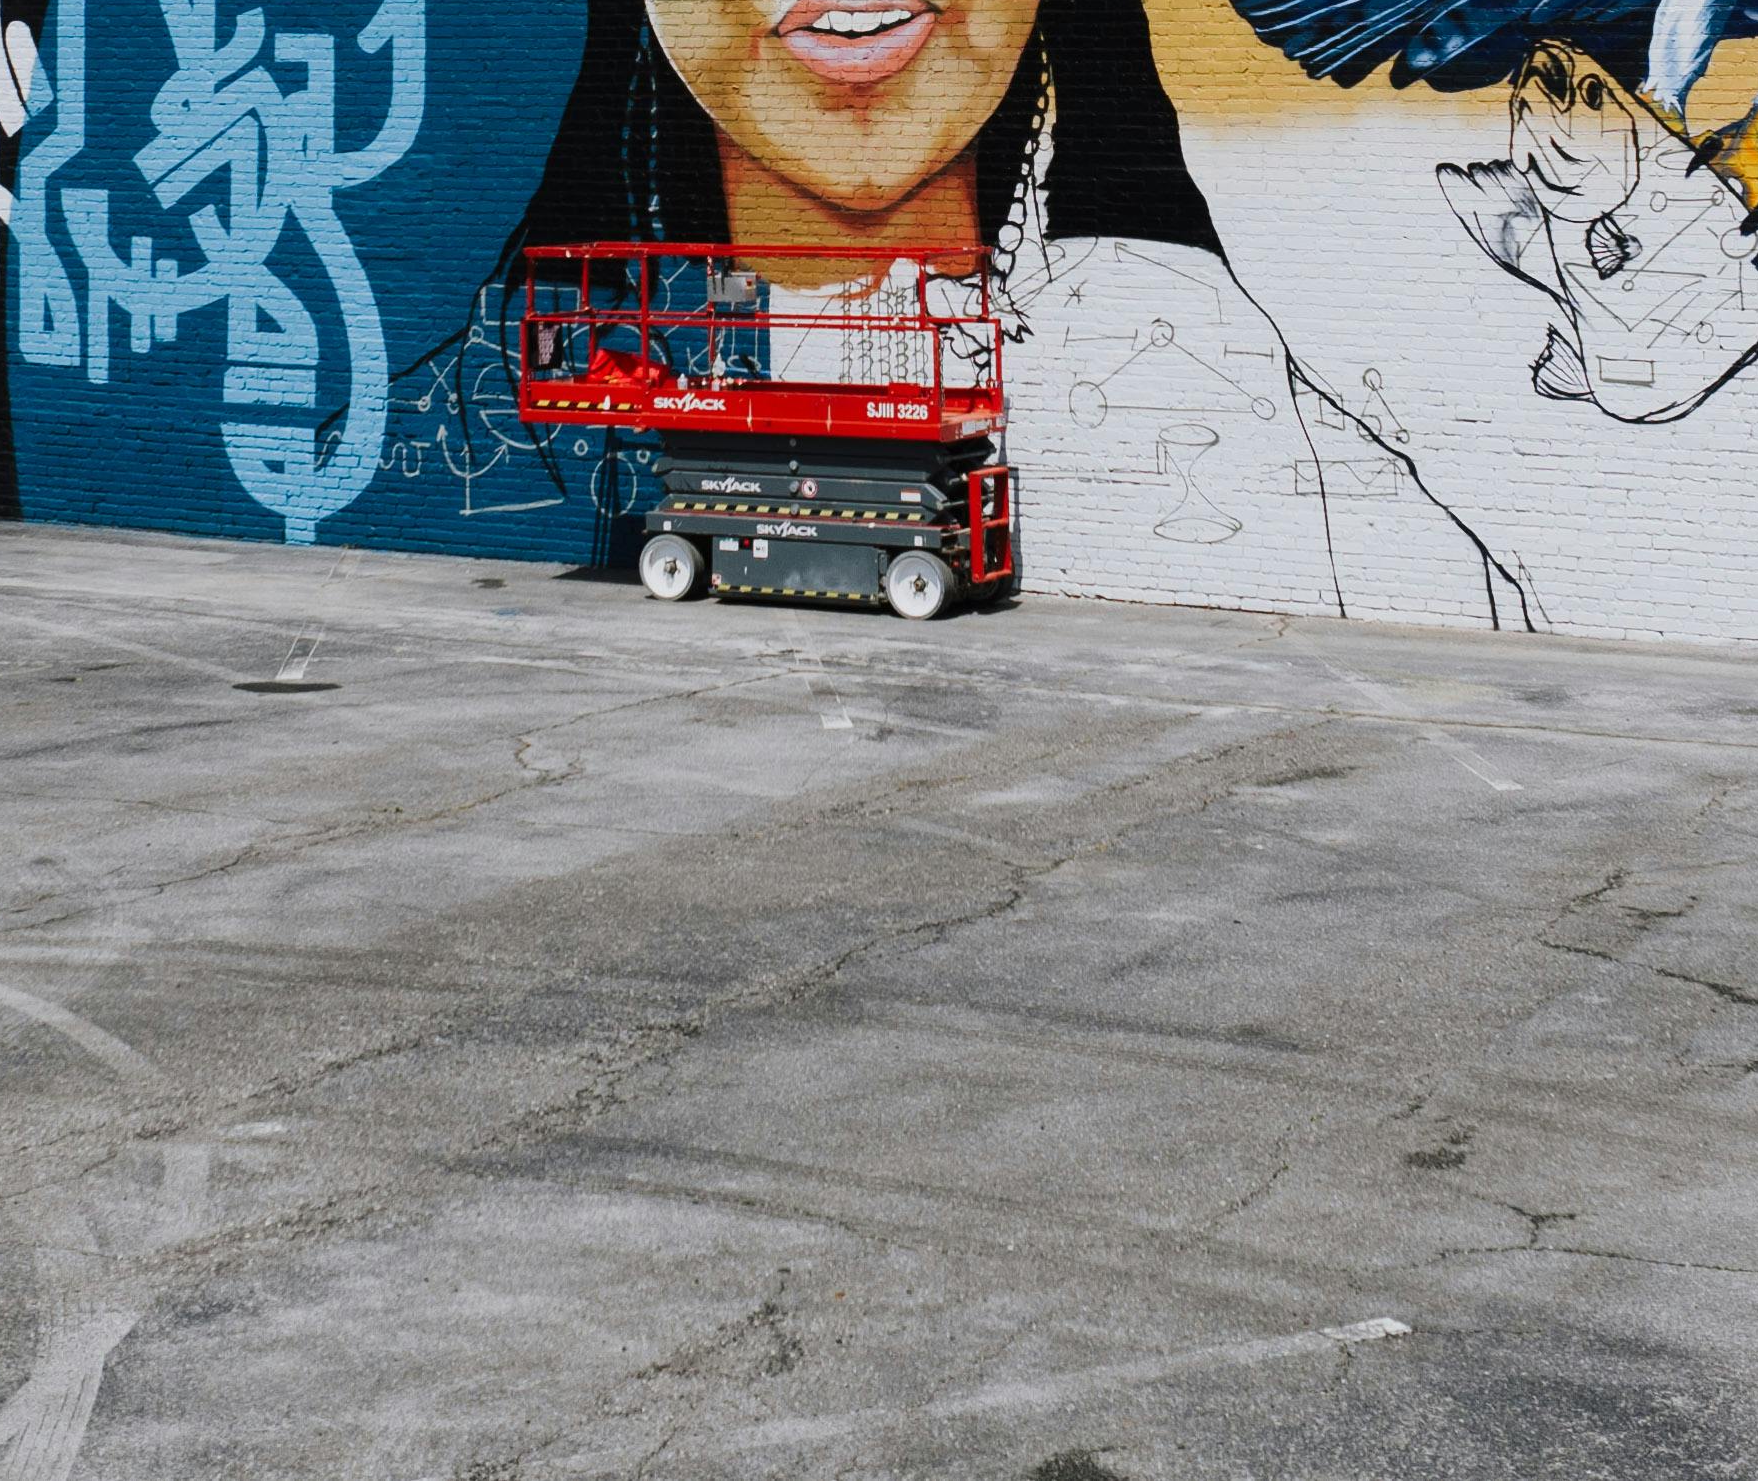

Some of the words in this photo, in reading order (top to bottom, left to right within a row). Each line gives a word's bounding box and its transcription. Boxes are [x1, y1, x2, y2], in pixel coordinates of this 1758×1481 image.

[653, 392, 727, 413] SKYJACK
[866, 401, 894, 418] SJIII
[897, 403, 929, 420] 3226
[701, 476, 762, 493] SKYJACK
[756, 520, 818, 537] SKYJACK
